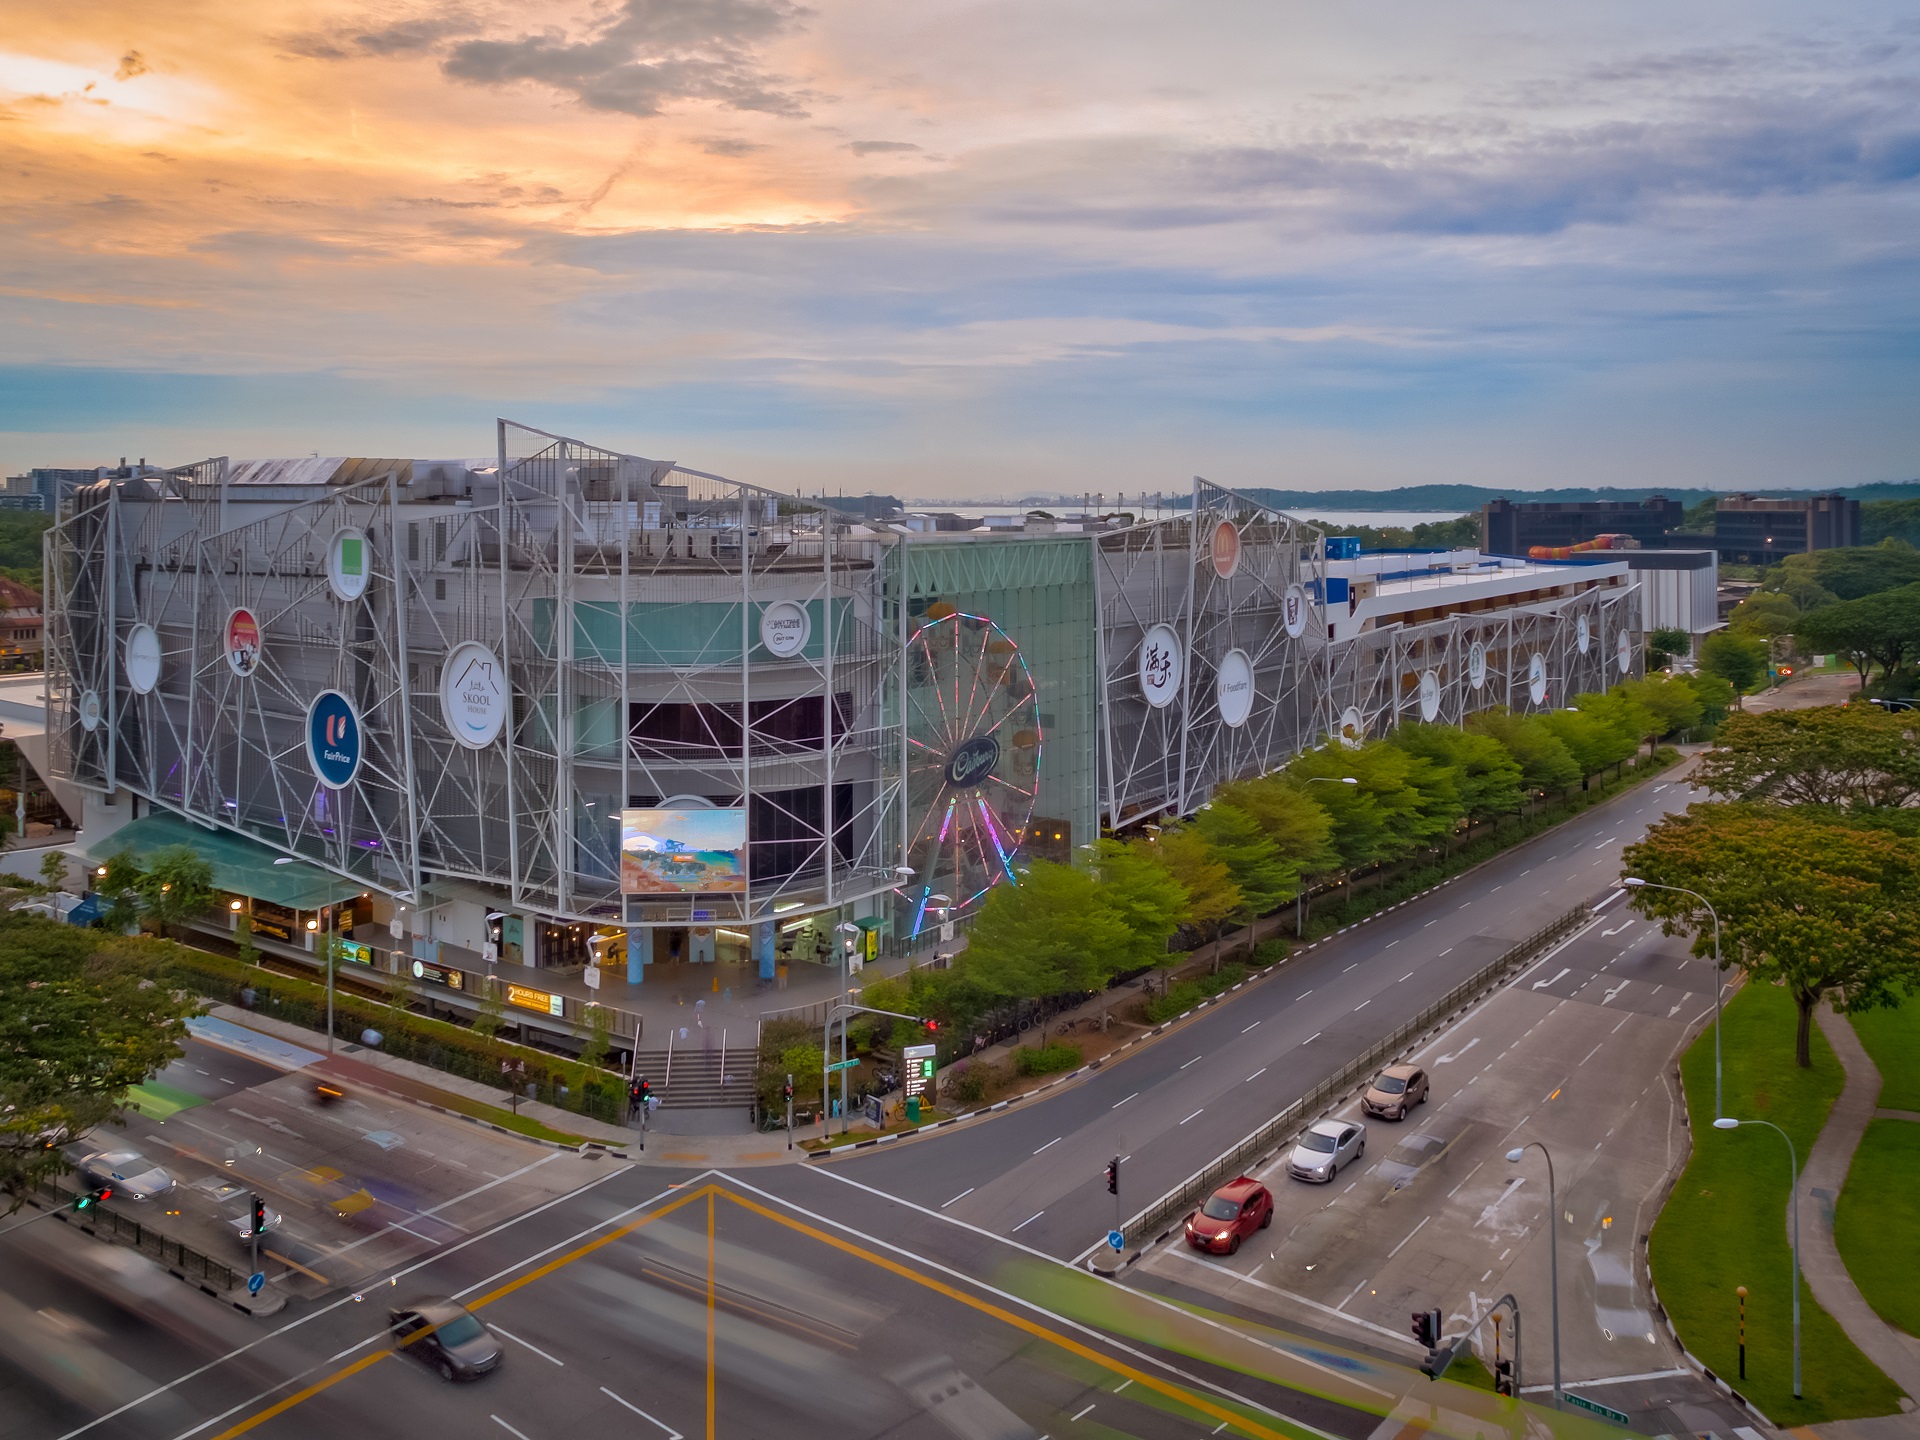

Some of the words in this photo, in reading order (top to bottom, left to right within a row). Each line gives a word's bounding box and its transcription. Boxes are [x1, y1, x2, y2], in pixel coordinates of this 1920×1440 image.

[462, 691, 491, 706] SKOOL
[323, 749, 351, 764] FairPrice
[952, 749, 995, 782] Cadbury
[507, 986, 515, 1002] 2
[514, 989, 534, 999] HOURS
[534, 993, 549, 1003] FREE
[1566, 1394, 1586, 1407] Pasir
[1590, 1403, 1603, 1414] Ris
[1606, 1409, 1616, 1419] Dr
